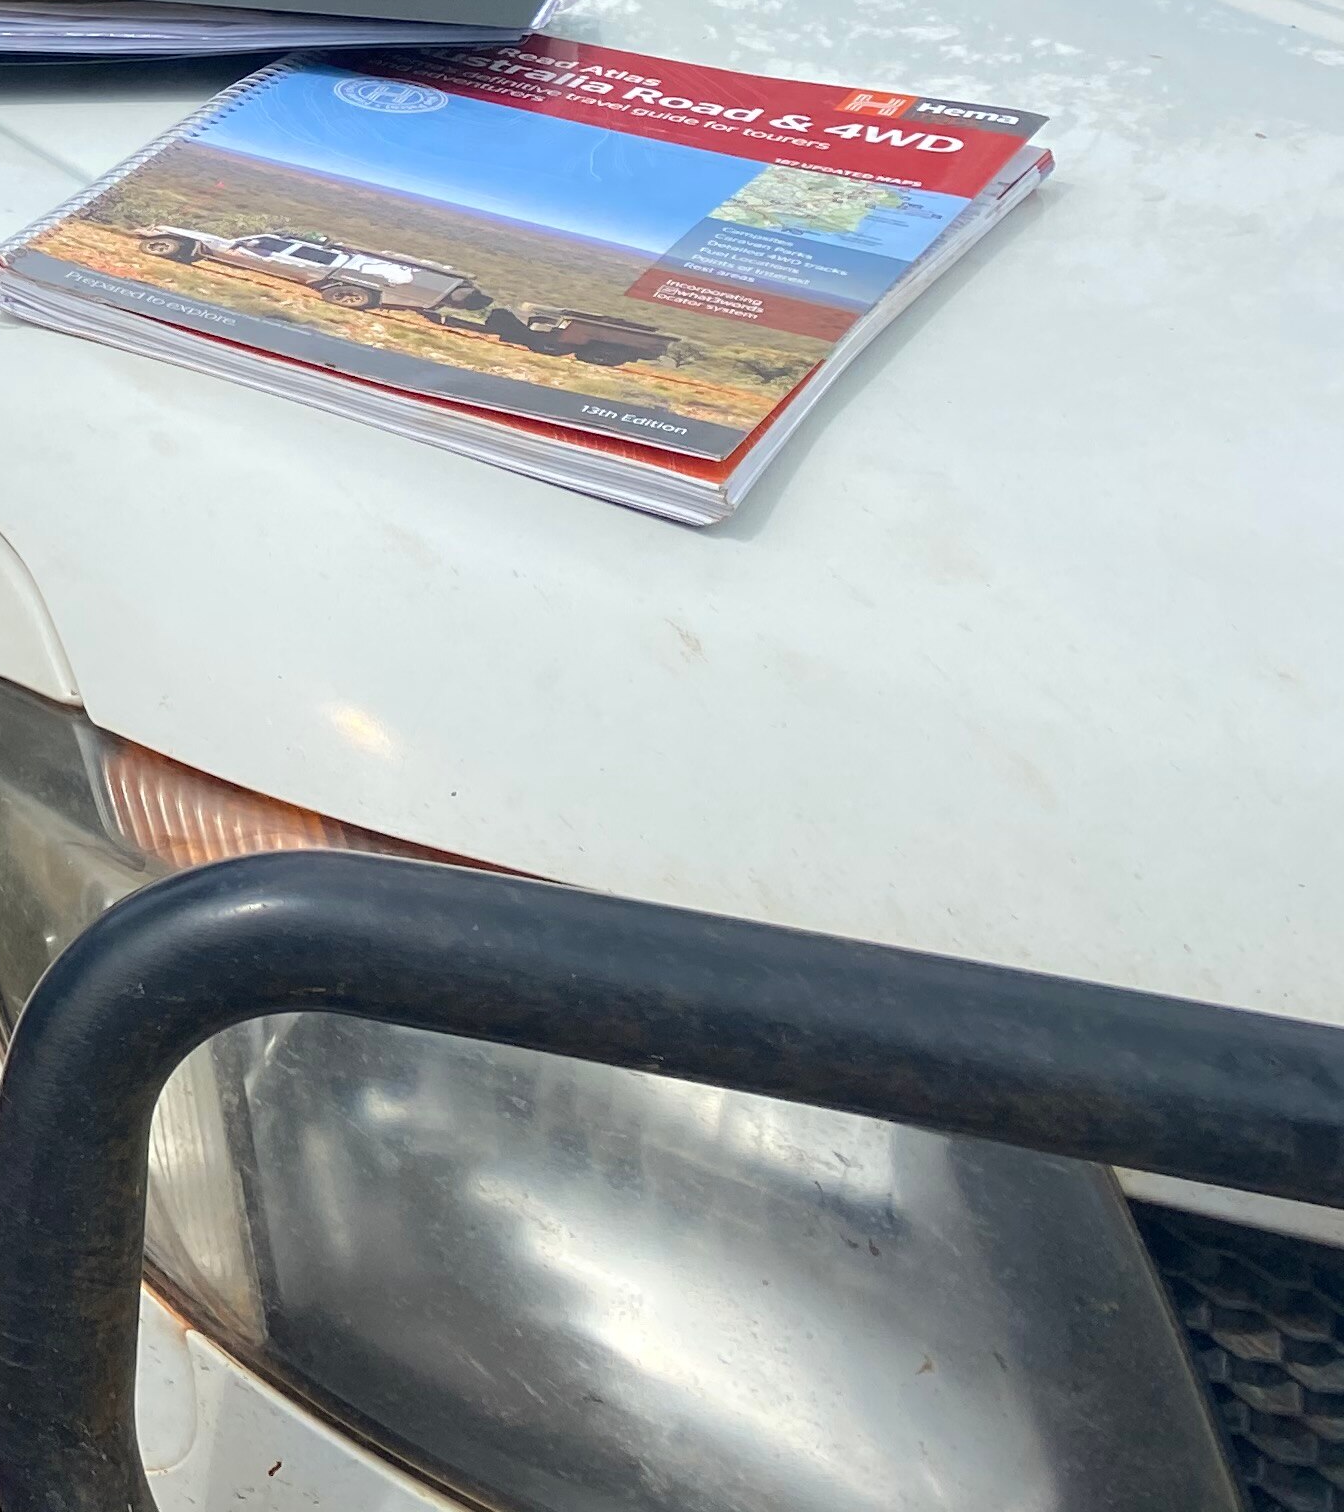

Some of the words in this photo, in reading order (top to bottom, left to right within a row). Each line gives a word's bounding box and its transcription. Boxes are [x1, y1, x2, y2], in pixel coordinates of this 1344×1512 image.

[413, 68, 547, 102] adventurers
[580, 65, 662, 87] Atlas
[463, 71, 562, 97] definitive
[566, 92, 630, 112] travel
[630, 107, 700, 126] guide
[703, 120, 740, 133] for
[742, 128, 831, 150] tourers
[621, 86, 765, 122] Road
[769, 114, 814, 133] &
[823, 123, 965, 153] 4WD
[916, 102, 1020, 125] Hema
[801, 163, 874, 179] UPDATED
[875, 175, 923, 188] MAPS
[714, 233, 772, 251] Caravan
[774, 246, 813, 260] Parks
[722, 227, 794, 247] Campsites
[691, 254, 735, 269] Points
[736, 264, 753, 273] of
[699, 247, 730, 258] Fuel
[731, 254, 800, 275] Locations
[707, 240, 766, 257] Detailed
[766, 254, 803, 266] 4WD
[683, 262, 715, 274] Rest
[716, 269, 756, 283] areas
[64, 270, 146, 300] Prepared
[146, 295, 166, 306] to
[166, 301, 238, 326] explore
[652, 291, 705, 307] locator
[706, 304, 758, 320] system
[665, 279, 763, 306] Incorporating
[676, 288, 765, 313] what3words
[580, 404, 618, 419] 13th
[621, 413, 689, 436] Edition
